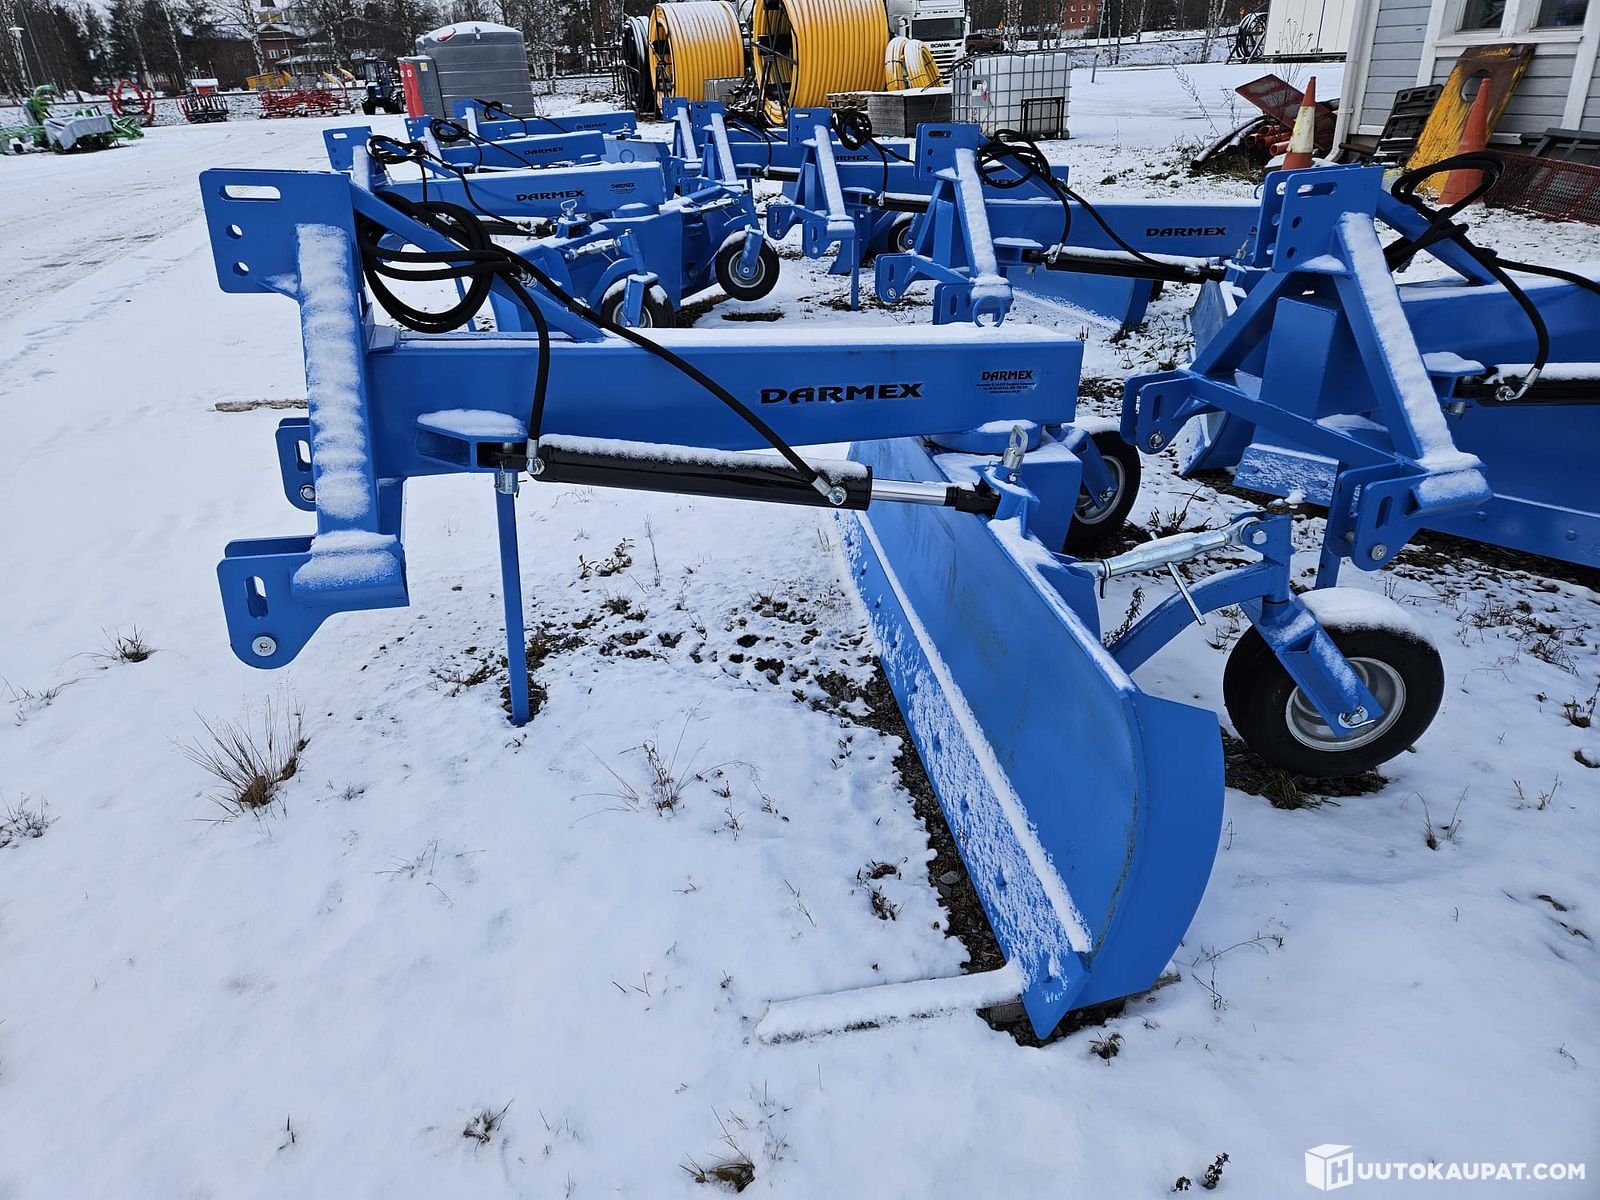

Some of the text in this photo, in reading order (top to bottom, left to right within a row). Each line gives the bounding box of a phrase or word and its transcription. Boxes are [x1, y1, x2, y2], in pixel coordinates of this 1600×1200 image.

[524, 146, 563, 155] DARMEX
[516, 189, 585, 202] DARMEX
[1145, 226, 1227, 237] DARMEX
[981, 369, 1034, 381] DARMEX
[760, 382, 924, 405] DARMEX
